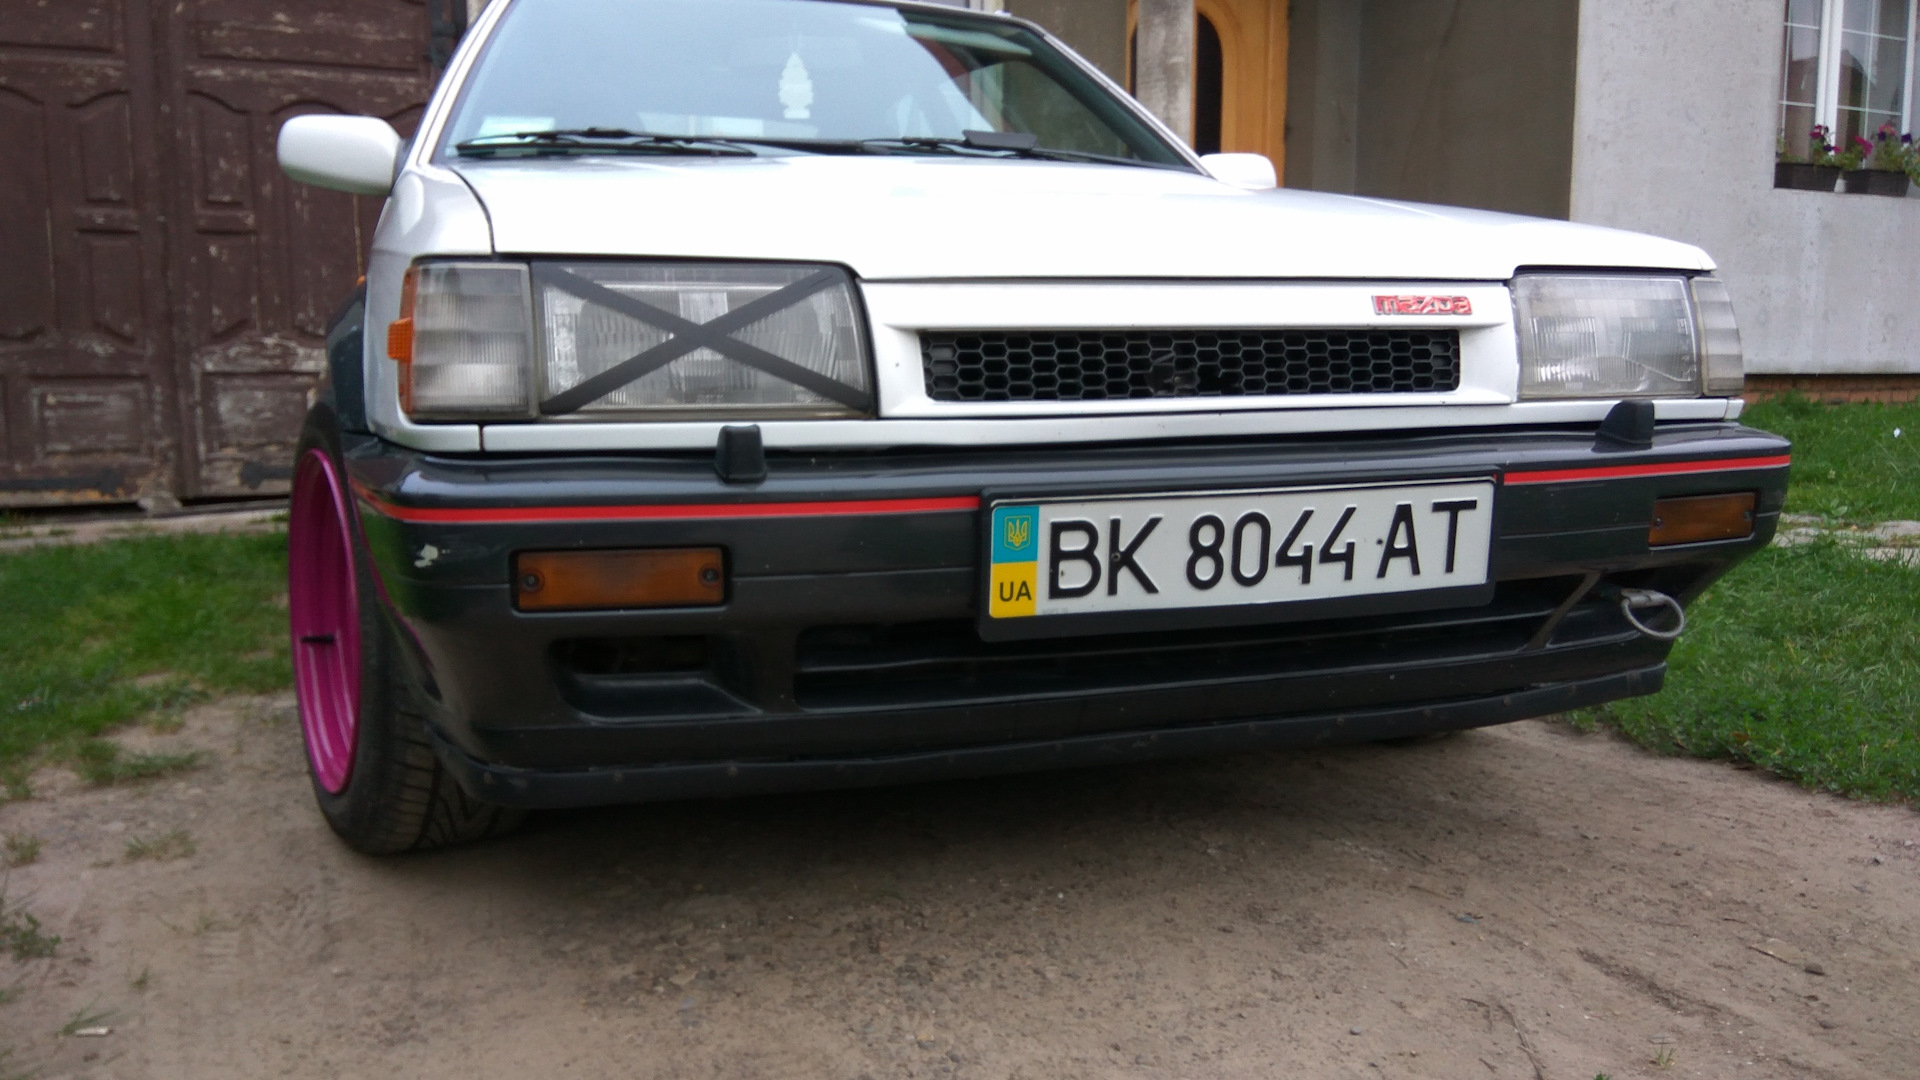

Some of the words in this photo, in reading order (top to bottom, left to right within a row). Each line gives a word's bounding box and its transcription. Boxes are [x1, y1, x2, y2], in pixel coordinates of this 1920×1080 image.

[1048, 516, 1164, 600] BK
[1185, 505, 1358, 591] 8044
[1376, 498, 1479, 579] AT
[999, 580, 1032, 602] UA
